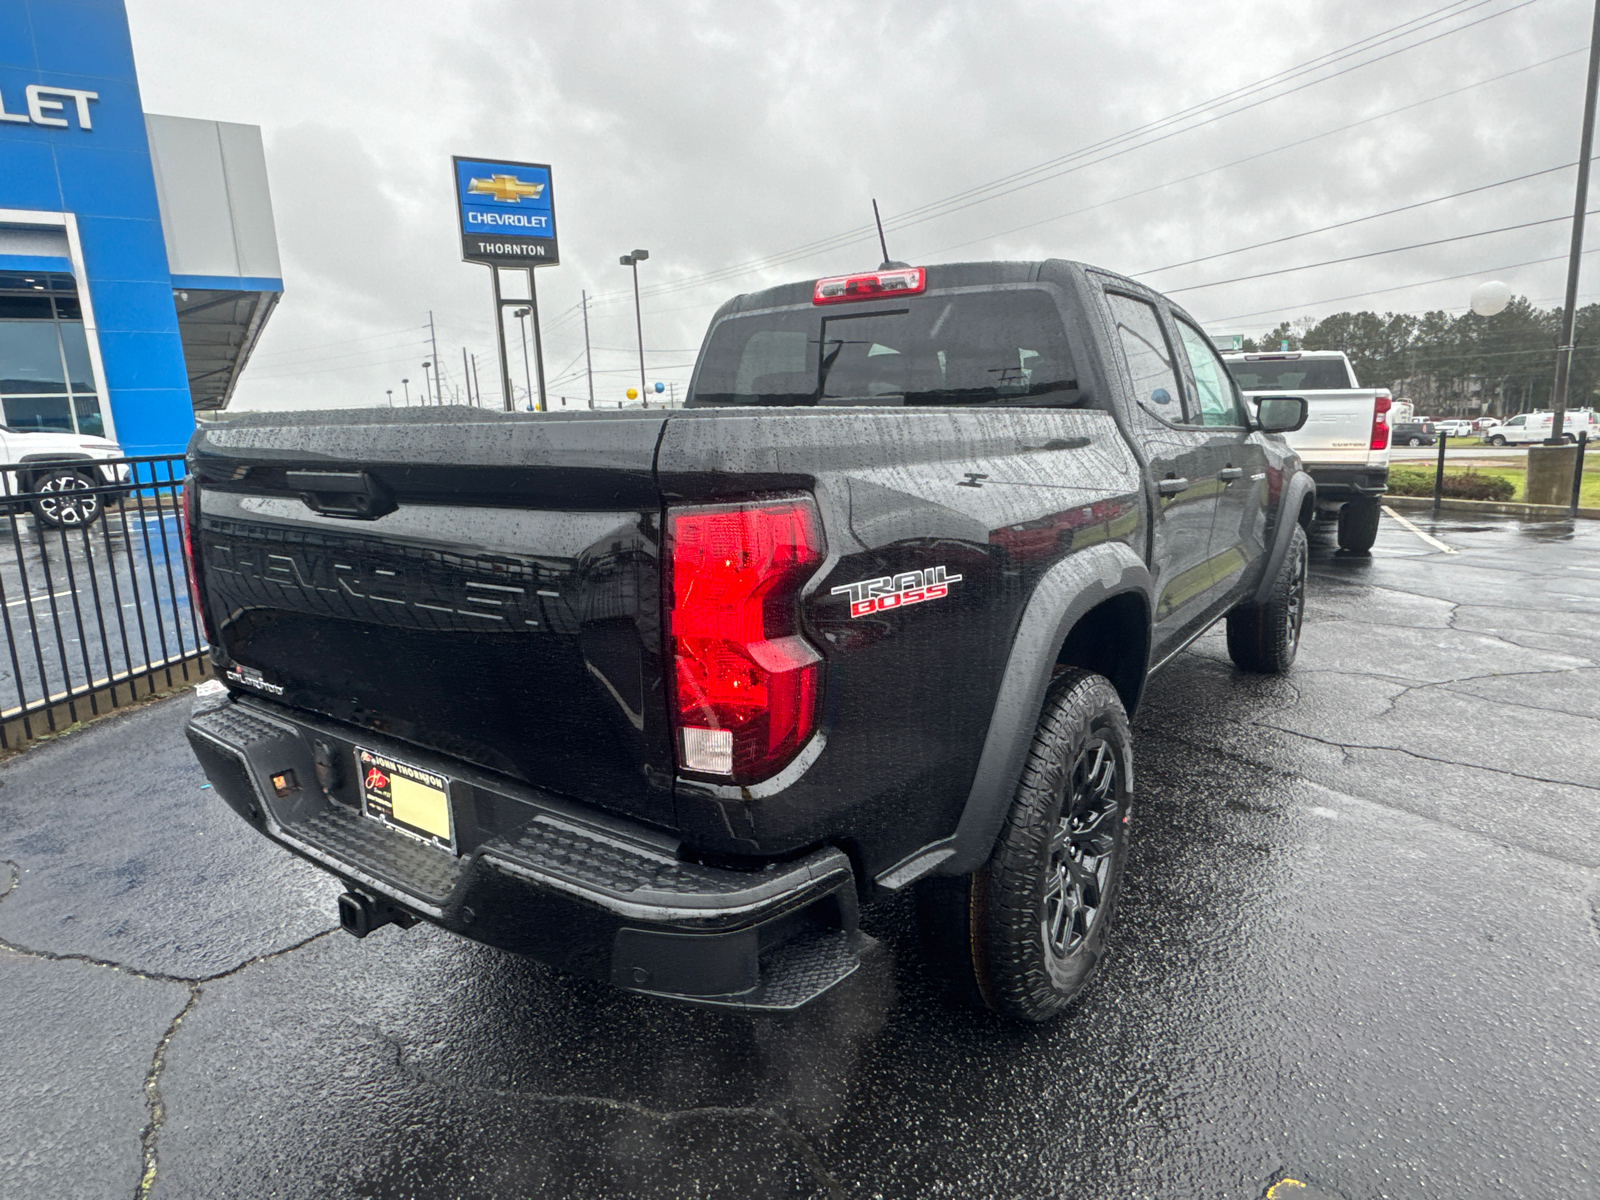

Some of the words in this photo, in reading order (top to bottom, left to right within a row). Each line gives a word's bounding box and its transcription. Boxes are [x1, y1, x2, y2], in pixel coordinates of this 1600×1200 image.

[0, 84, 99, 130] LET
[468, 212, 547, 227] CHEVROLET
[478, 242, 545, 256] THORNTON
[831, 565, 963, 602] TRAIL
[850, 582, 948, 619] BOSS
[226, 670, 284, 696] COLORADO
[375, 756, 397, 771] JOHN
[396, 763, 443, 789] THORNTON
